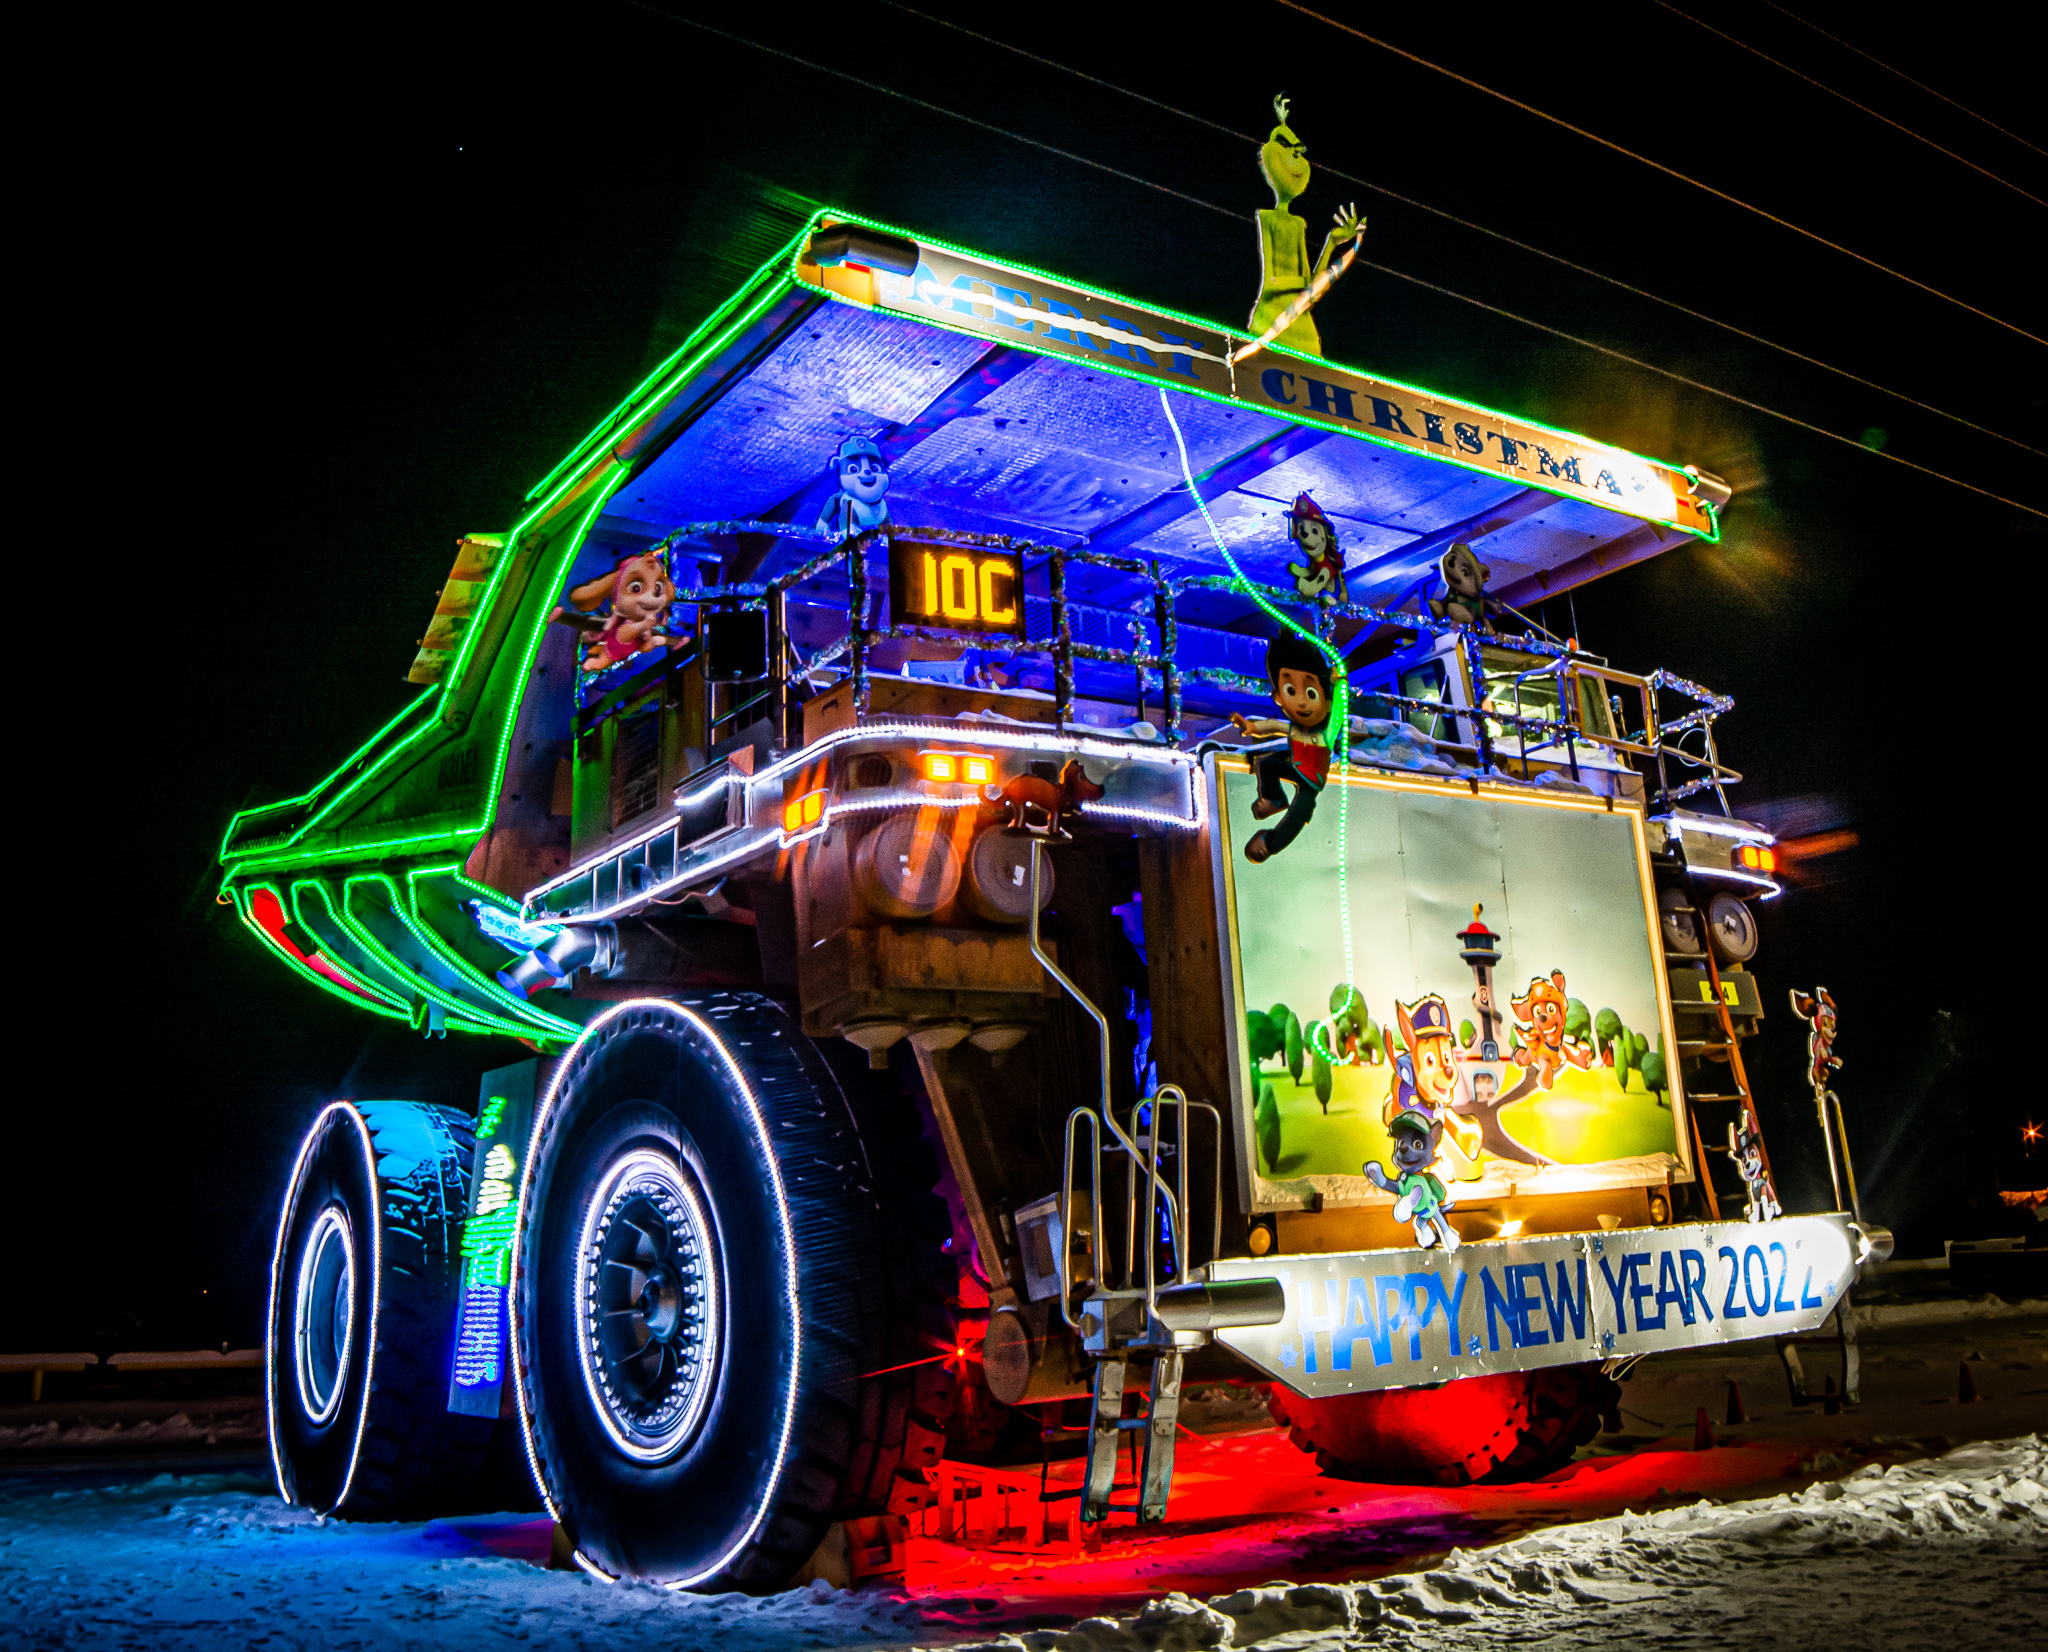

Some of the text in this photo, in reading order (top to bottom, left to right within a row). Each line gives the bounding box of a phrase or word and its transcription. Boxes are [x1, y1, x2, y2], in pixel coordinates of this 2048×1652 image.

[904, 262, 1205, 380] MERRY
[1298, 1269, 1467, 1375] HAPPY
[1479, 1258, 1587, 1352] NEW
[1600, 1248, 1714, 1335] YEAR
